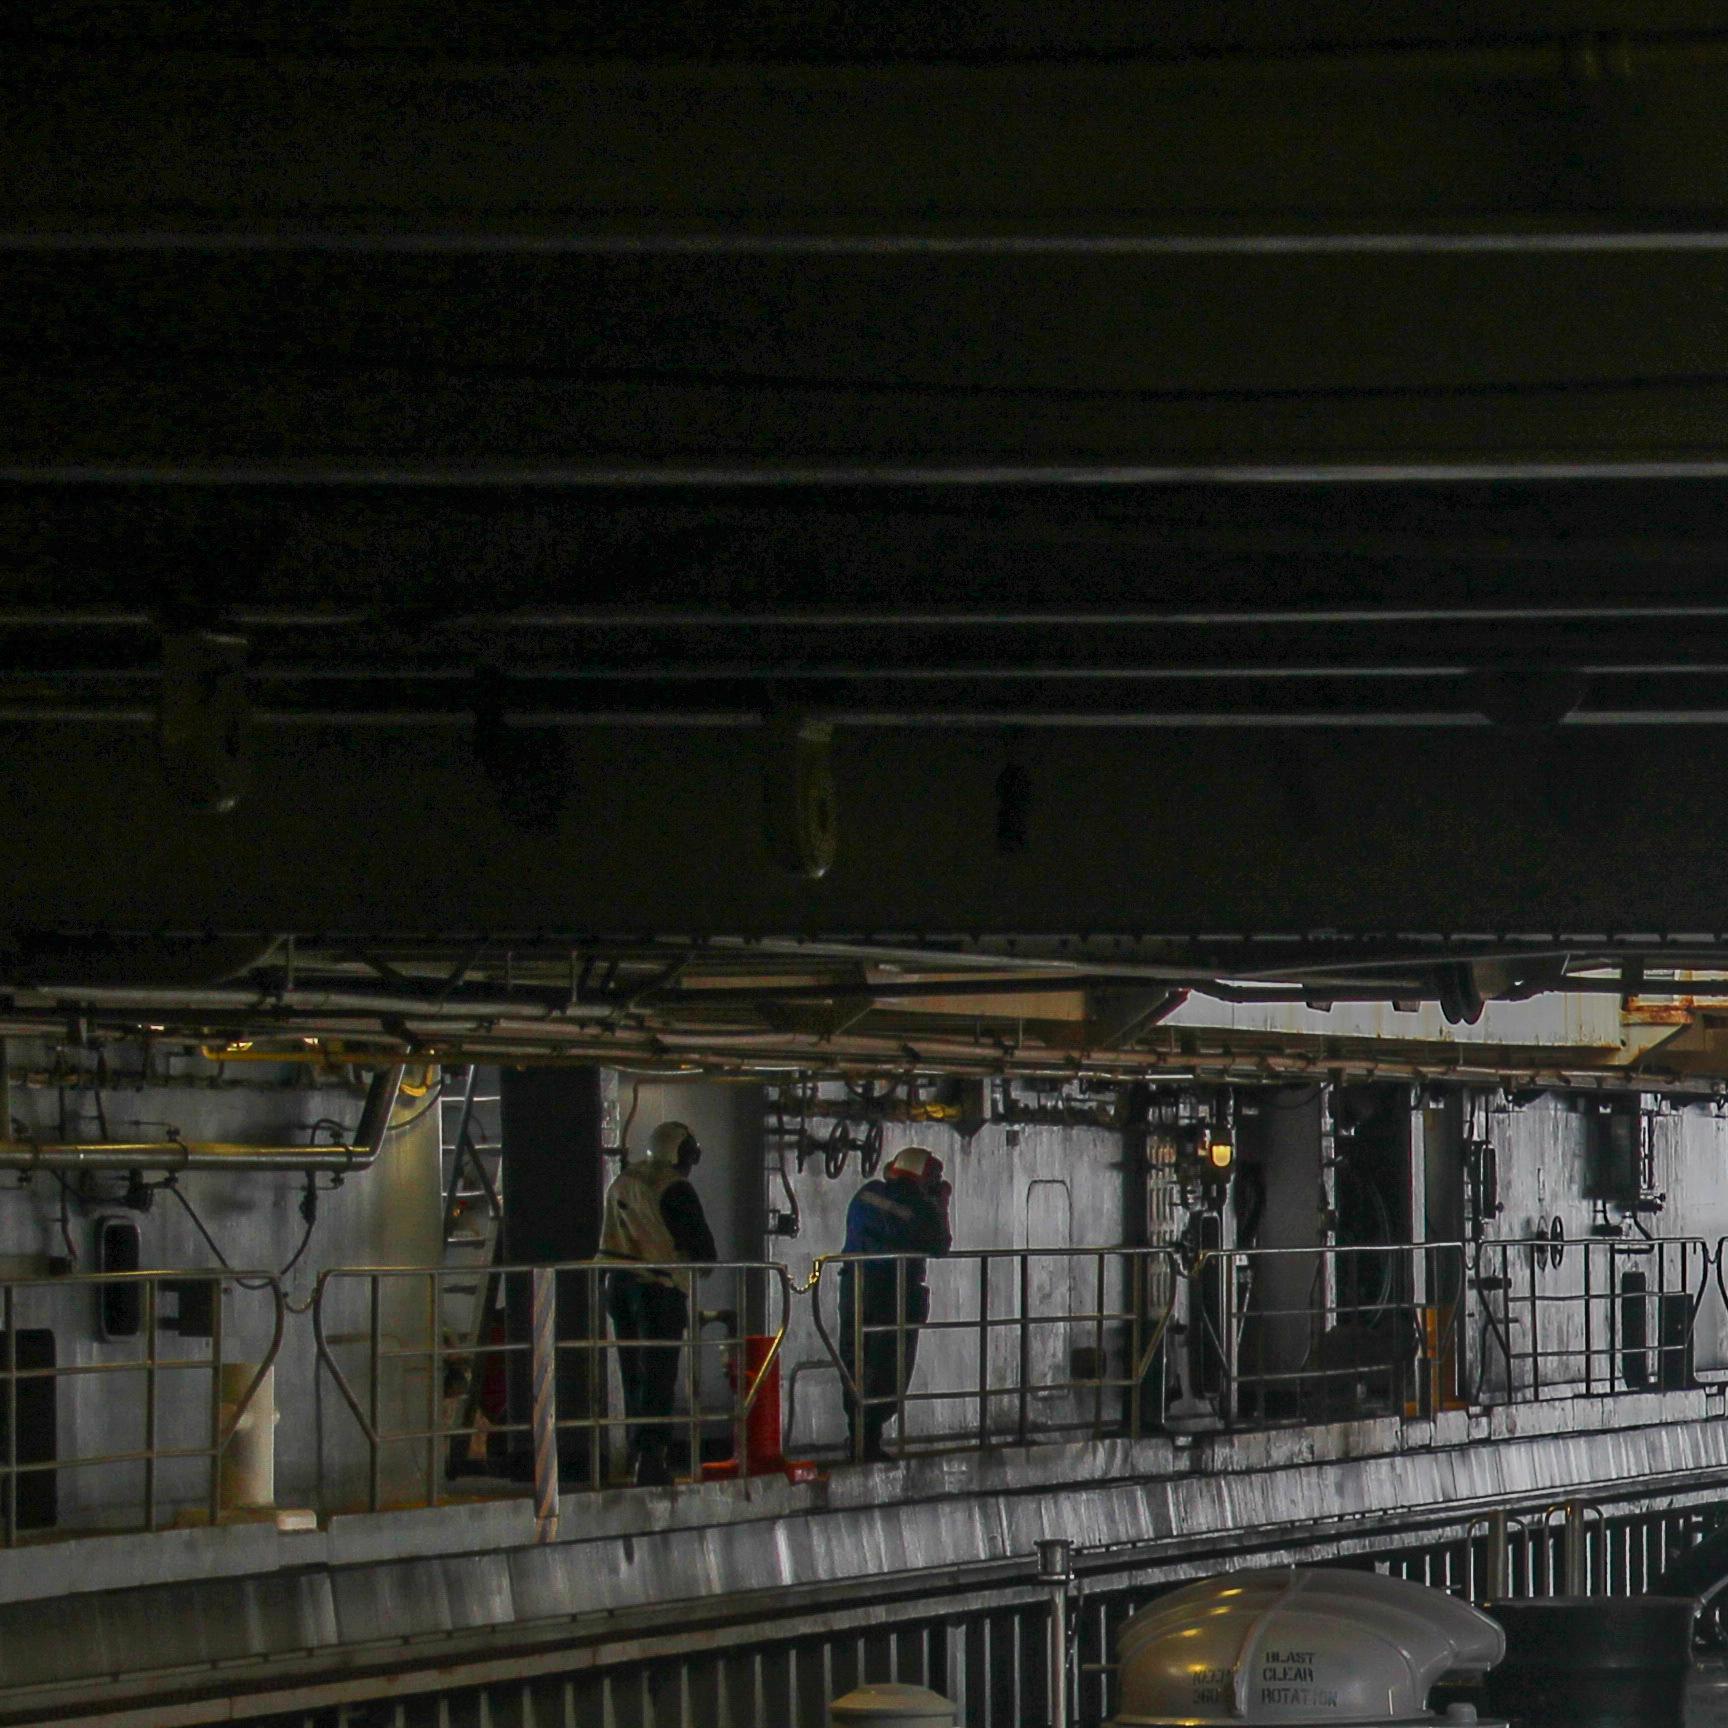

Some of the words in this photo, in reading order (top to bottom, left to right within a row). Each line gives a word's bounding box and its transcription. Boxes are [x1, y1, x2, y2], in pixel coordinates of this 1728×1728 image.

[1265, 1651, 1316, 1664] BLAST
[1262, 1667, 1314, 1682] CLEAR
[1261, 1687, 1338, 1707] ROTATION
